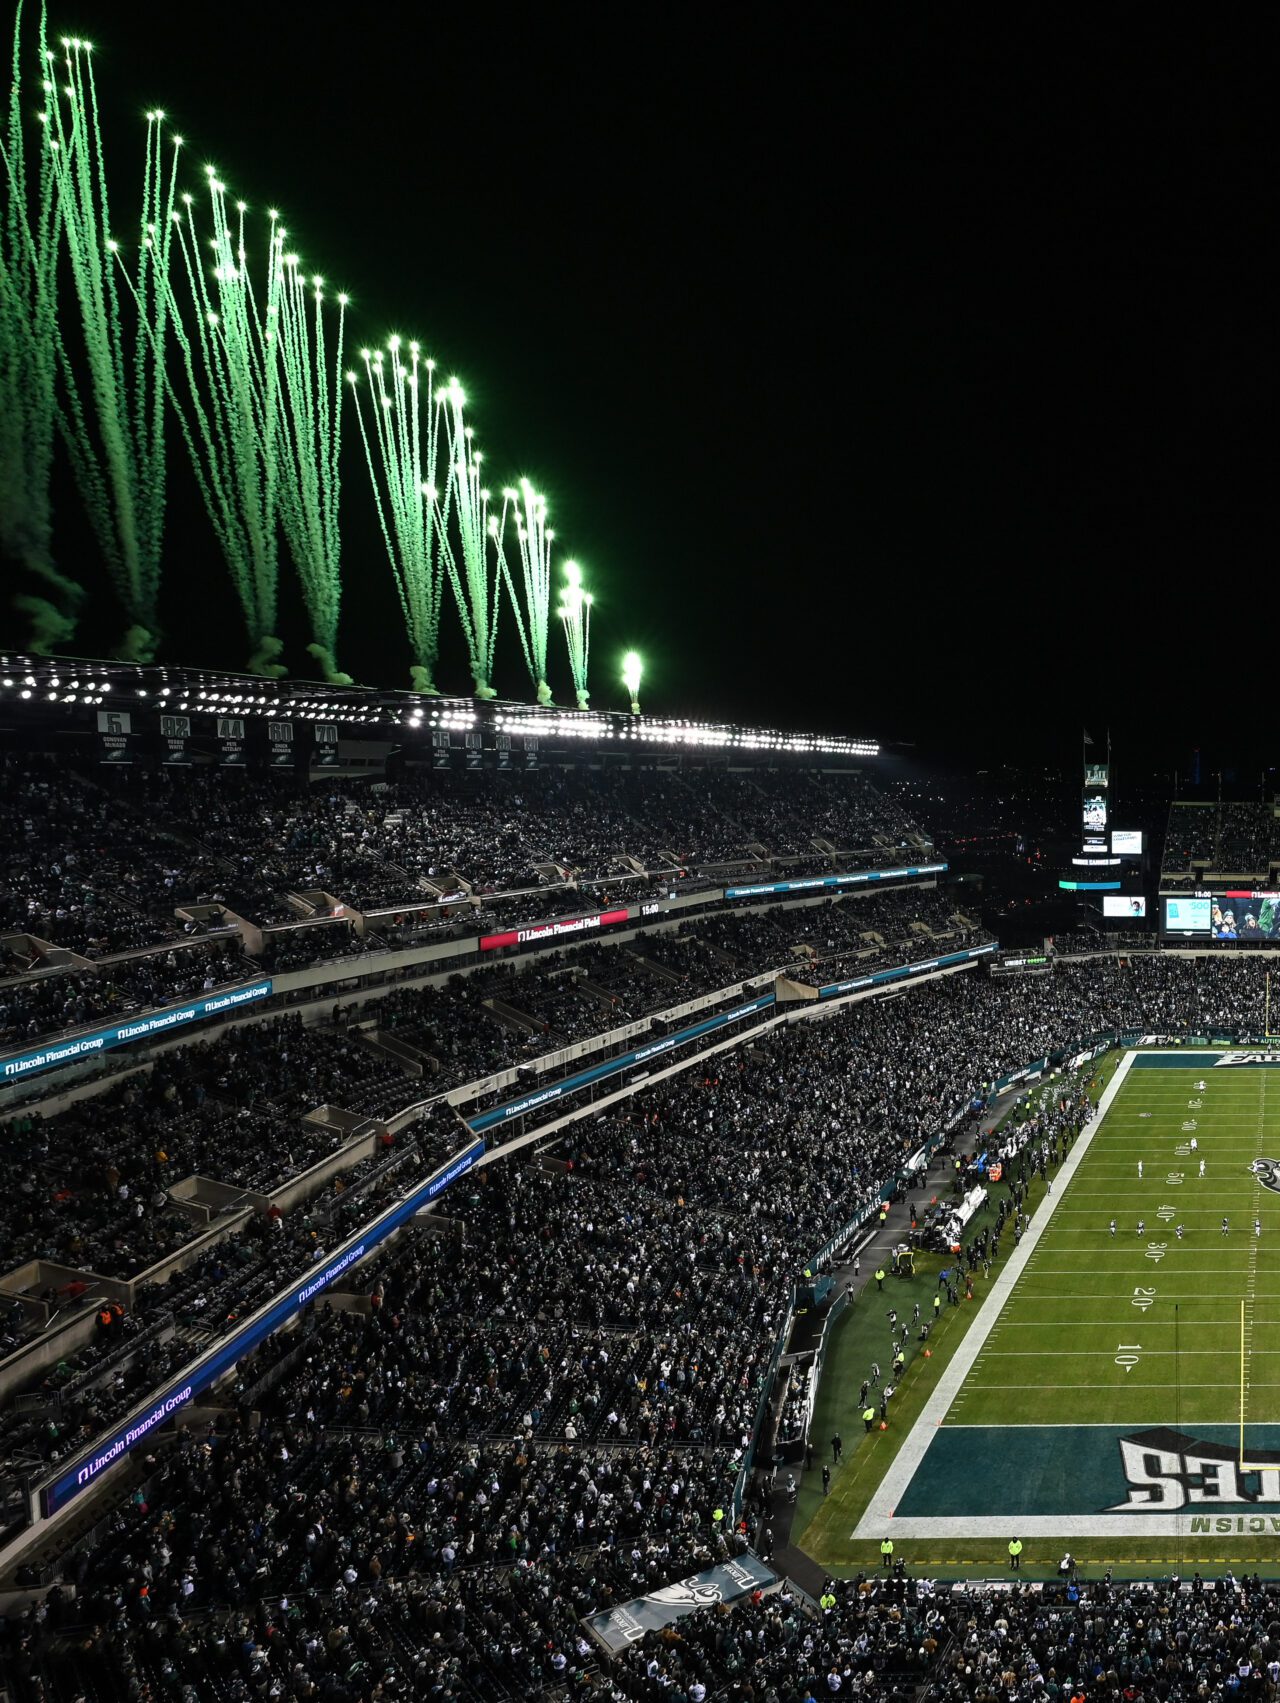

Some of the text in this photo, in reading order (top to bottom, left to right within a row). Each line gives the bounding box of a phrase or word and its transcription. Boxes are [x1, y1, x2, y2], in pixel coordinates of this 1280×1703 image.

[107, 714, 122, 735] 5
[163, 717, 188, 738] 92
[220, 720, 243, 740] 44
[270, 723, 292, 742] 60
[317, 726, 337, 743] 70
[642, 904, 658, 916] 15:00
[526, 916, 600, 942] Lincoln Financial Field
[212, 987, 268, 1010] Lincoln Financial Group
[125, 1010, 195, 1037] Lincoln Financial Group
[15, 1038, 103, 1073] Lincoln Financial Group
[1188, 1099, 1202, 1109] 20
[1166, 1172, 1184, 1184] 50
[1156, 1205, 1176, 1218] 40
[816, 1195, 881, 1270] PHILADELPHIA EAGLES
[1144, 1242, 1168, 1259] 30
[305, 1246, 364, 1298] Lincoln Financial Group
[1131, 1286, 1157, 1307] 20
[1114, 1343, 1142, 1365] 10
[90, 1386, 191, 1475] Lincoln Financial Group
[722, 1564, 741, 1583] Lincoln
[609, 1612, 632, 1634] Lincoln
